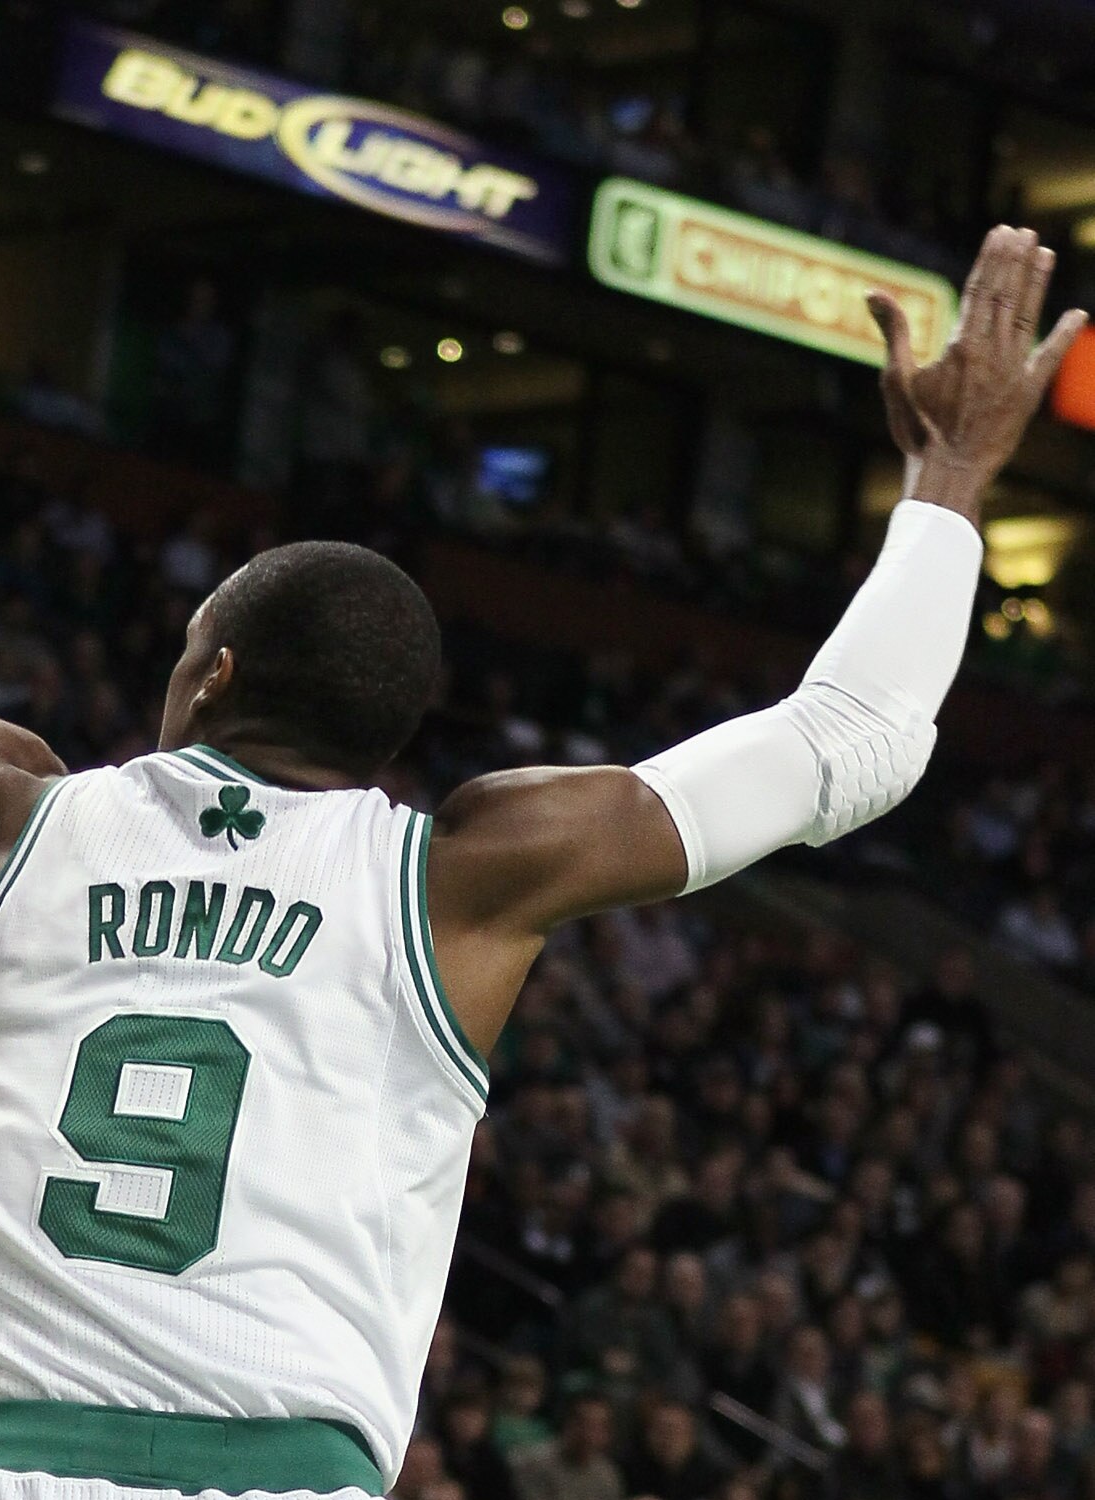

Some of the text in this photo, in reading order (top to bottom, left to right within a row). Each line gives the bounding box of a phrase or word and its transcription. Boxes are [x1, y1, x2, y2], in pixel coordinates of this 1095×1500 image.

[102, 49, 539, 218] BUD LIGHT
[88, 880, 324, 978] RONDO
[37, 1012, 253, 1277] 9
